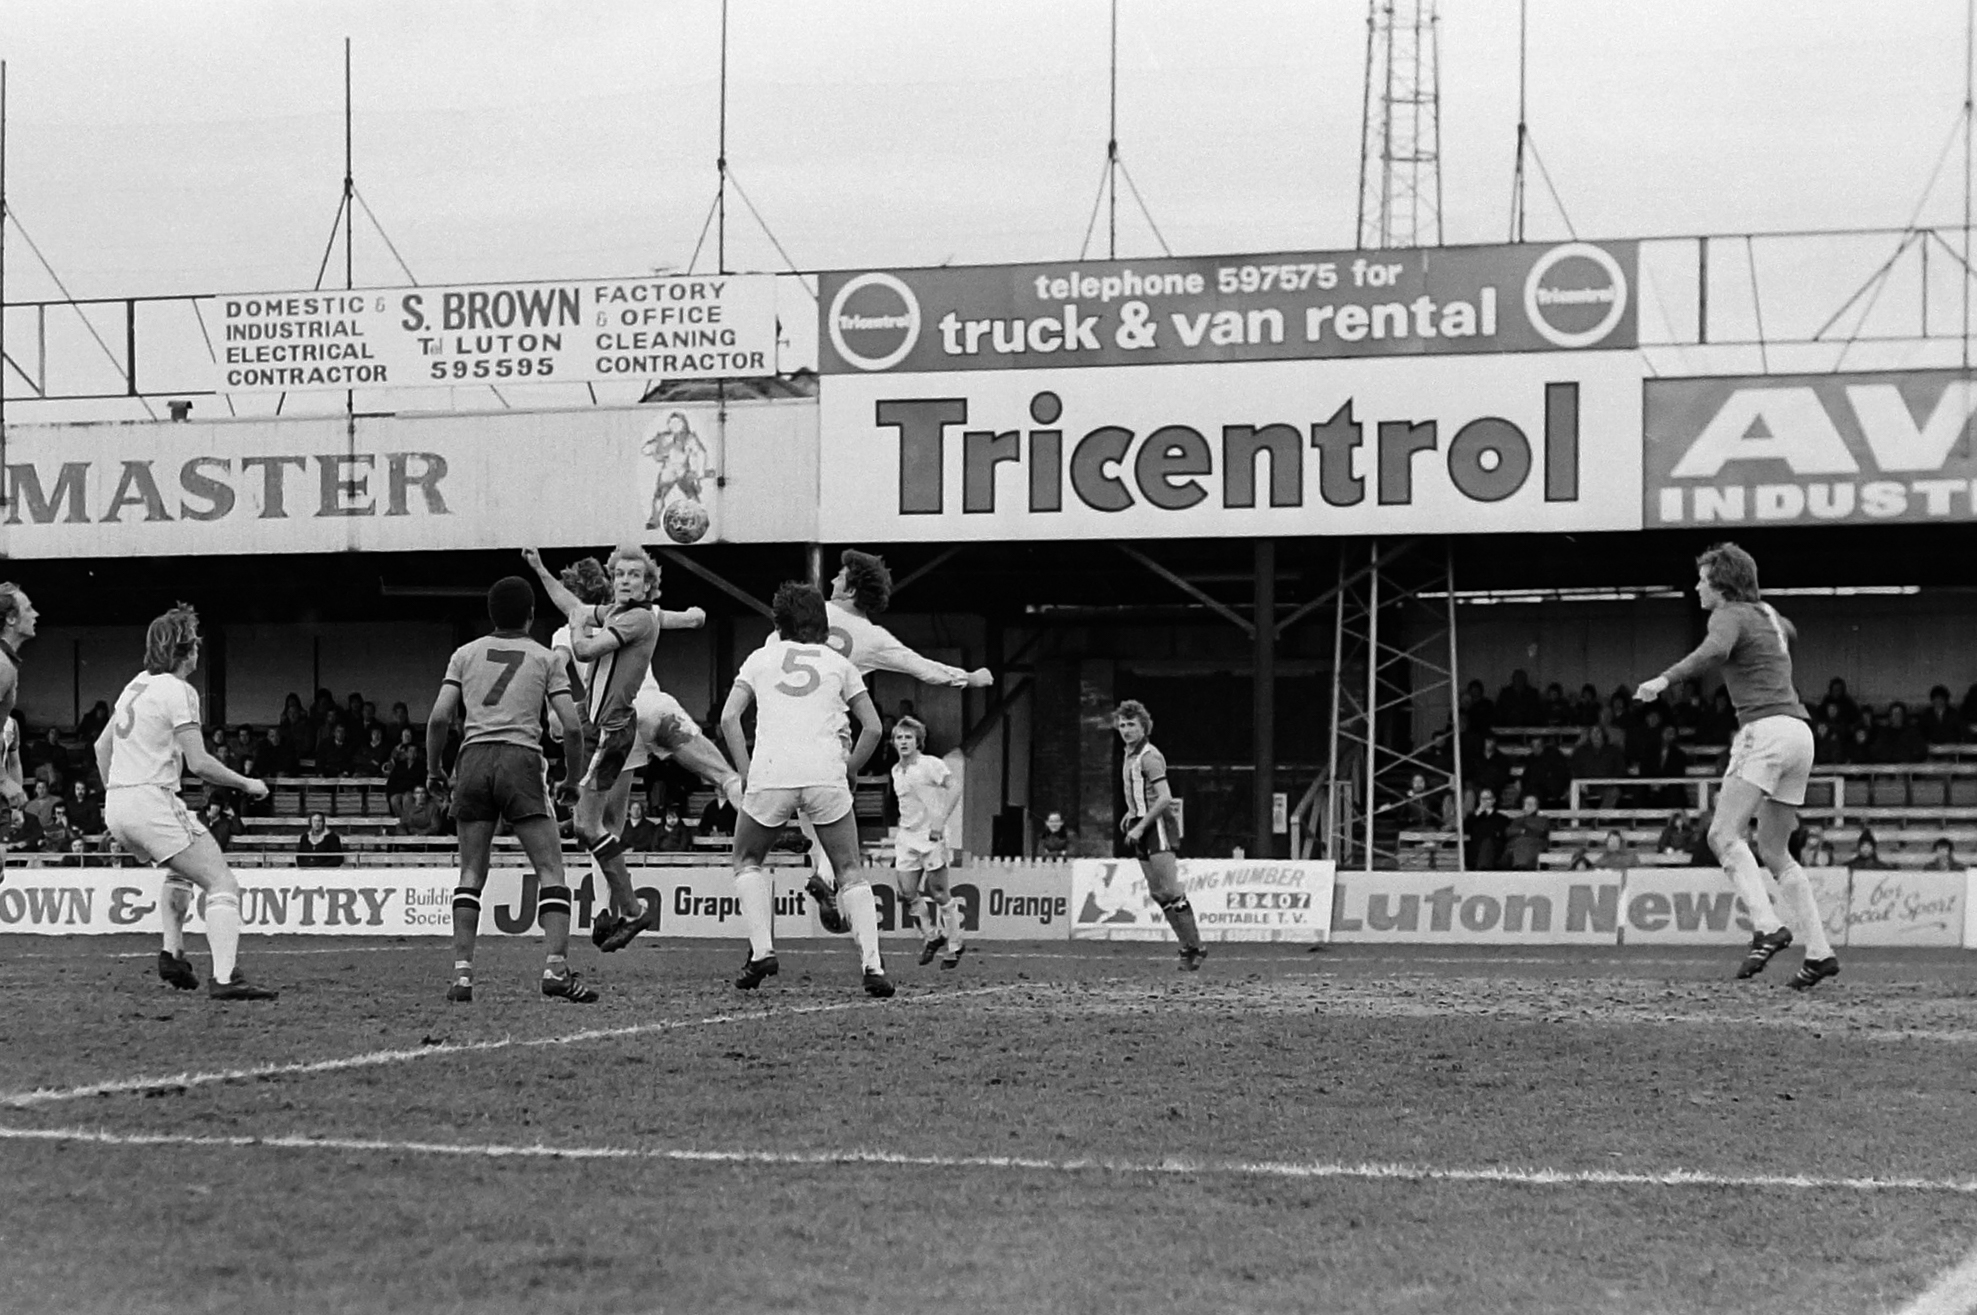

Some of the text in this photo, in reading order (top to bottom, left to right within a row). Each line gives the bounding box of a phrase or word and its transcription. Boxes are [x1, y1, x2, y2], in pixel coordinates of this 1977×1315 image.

[1033, 258, 1403, 303] telephone 597575 for
[594, 281, 726, 304] FACTORY
[225, 296, 365, 318] DOMESTIC
[401, 287, 581, 332] S. BROWN
[620, 305, 722, 326] OFFICE
[226, 319, 364, 341] INDUSTRIAL
[938, 286, 1497, 355] truck & van rental
[456, 333, 562, 355] LUTON
[596, 329, 736, 351] CLEANING
[226, 342, 375, 363] ELECTRICAL
[596, 351, 765, 373] CONTRACTOR
[227, 364, 388, 386] CONTRACTOR
[430, 357, 554, 379] 595595
[876, 381, 1580, 515] Tricentrol
[2, 451, 452, 525] MASTER
[1659, 479, 1977, 523] INDUST
[483, 649, 527, 706] 7
[774, 648, 821, 697] 5
[115, 682, 149, 740] 3
[1222, 867, 1306, 888] NUMBER
[108, 887, 156, 925] &
[182, 886, 397, 926] UNTRY
[404, 886, 454, 906] Buildi
[674, 886, 806, 922] Grapuit
[989, 888, 1067, 925] Orange
[1333, 883, 1552, 932] Luton
[404, 907, 452, 926] Socie
[1199, 913, 1271, 923] PORTABLE
